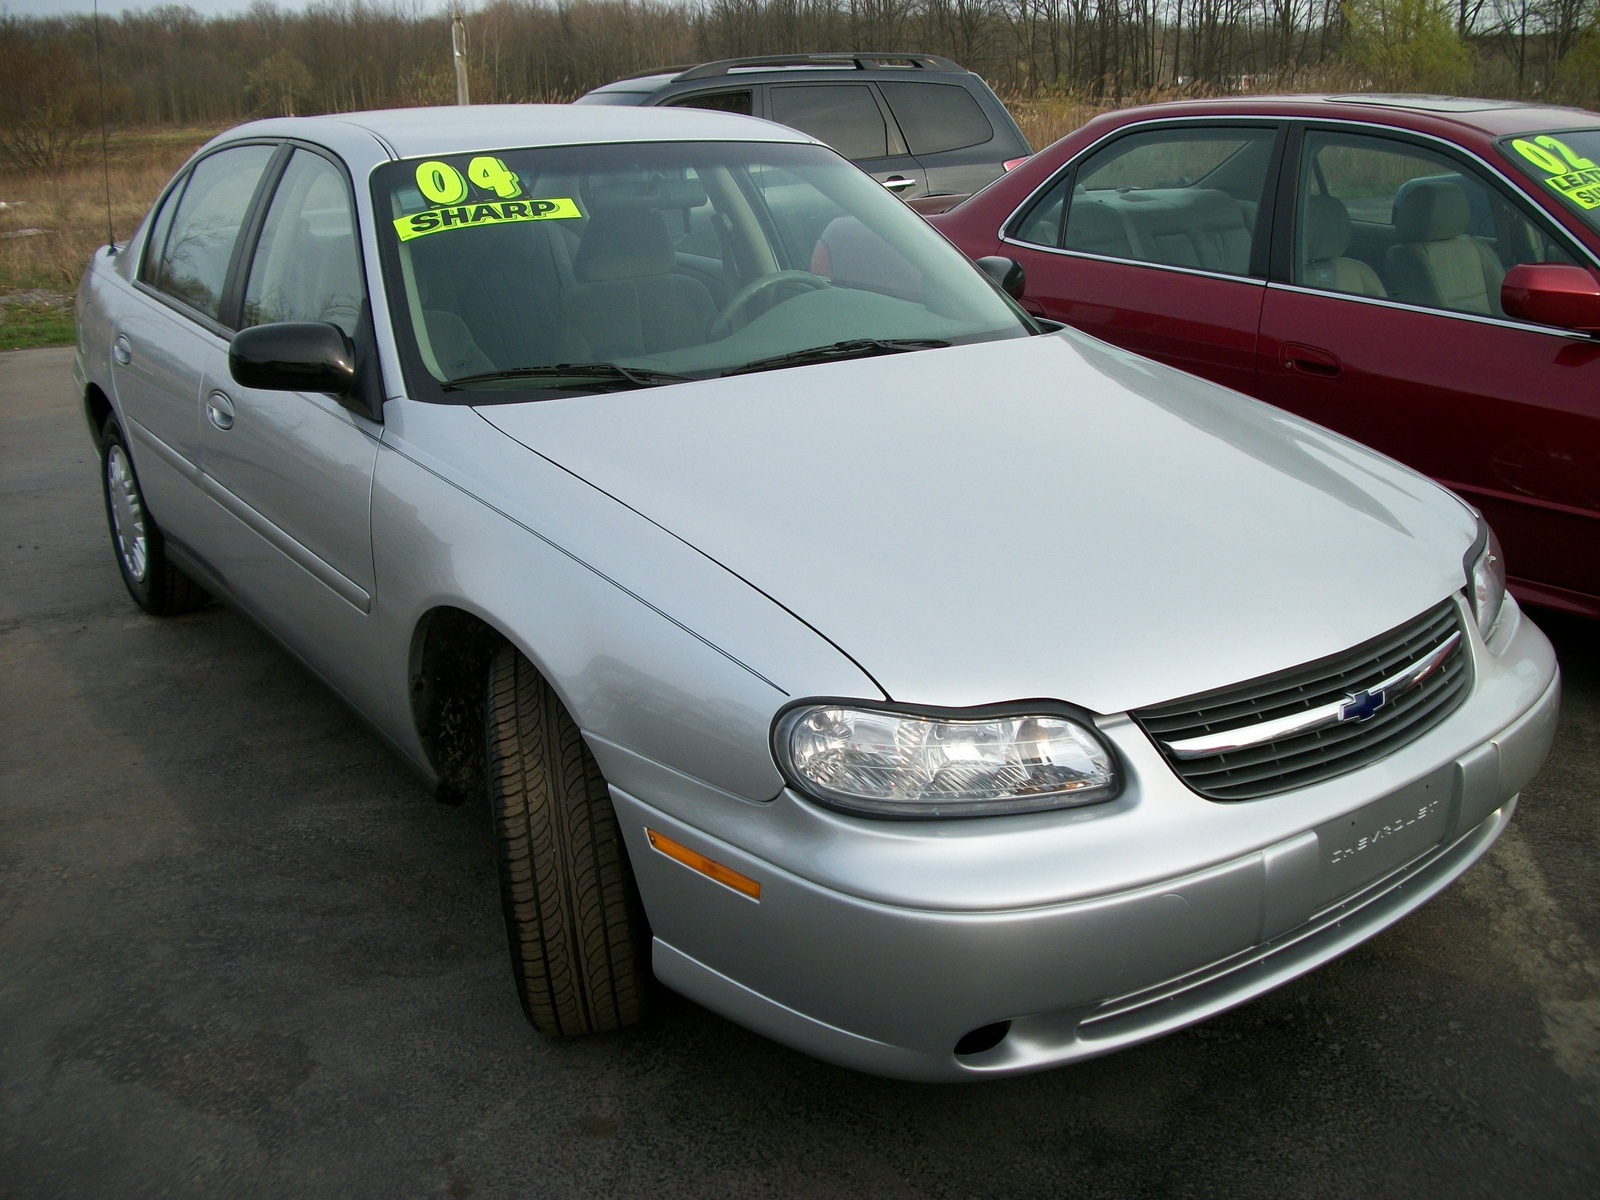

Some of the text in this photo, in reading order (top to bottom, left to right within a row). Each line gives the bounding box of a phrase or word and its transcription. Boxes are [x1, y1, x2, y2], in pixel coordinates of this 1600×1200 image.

[1512, 135, 1598, 175] 02
[415, 156, 523, 205] 04
[410, 201, 560, 232] SHARP
[1331, 800, 1439, 864] CHEVROLET
